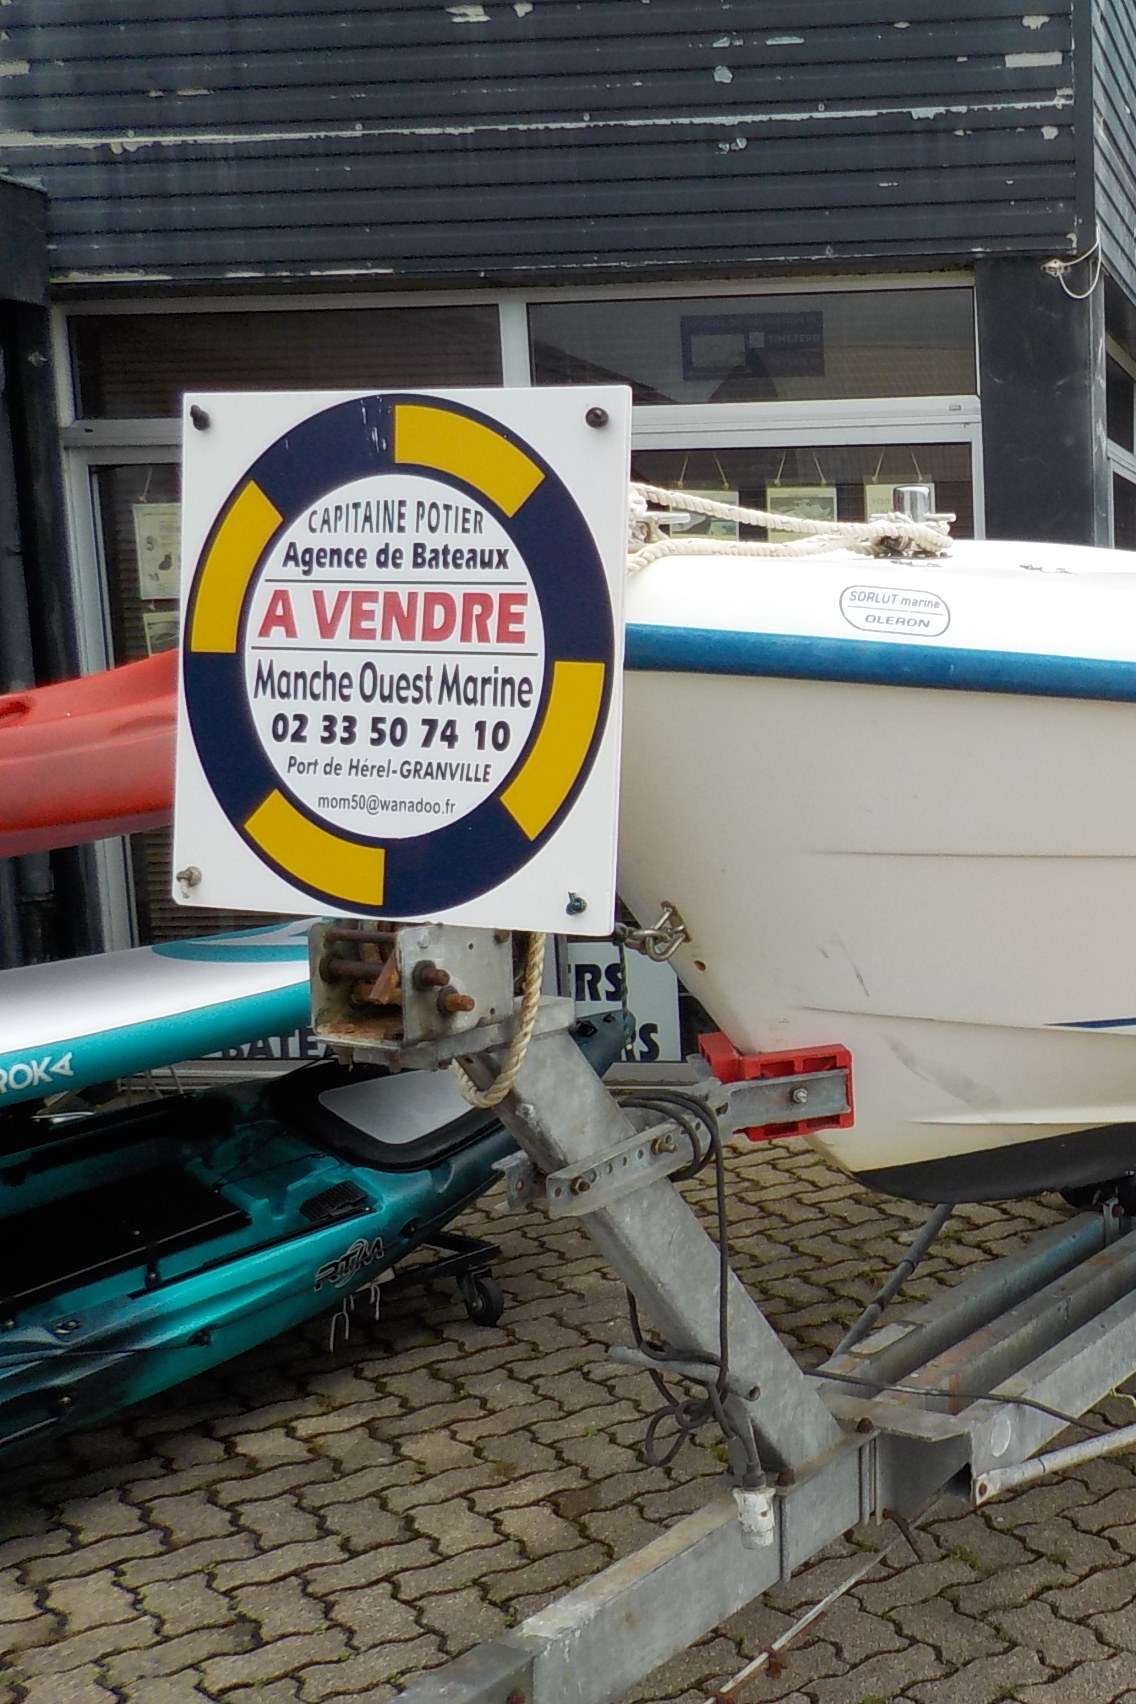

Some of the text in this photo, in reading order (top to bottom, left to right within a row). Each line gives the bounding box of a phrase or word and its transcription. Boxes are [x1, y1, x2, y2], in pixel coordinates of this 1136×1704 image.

[308, 499, 484, 534] CAPITAINE POTIER
[282, 541, 509, 576] Agence de Bateaux
[257, 589, 528, 644] A VENDRE
[849, 591, 940, 609] SORLUT marine
[865, 614, 930, 628] OLERON
[253, 659, 534, 708] Manche Ouest Marine
[272, 713, 511, 751] 02 33 50 74 10
[287, 756, 319, 775] Port
[323, 757, 343, 776] de
[317, 794, 456, 815] mom50@wanadoo.fr
